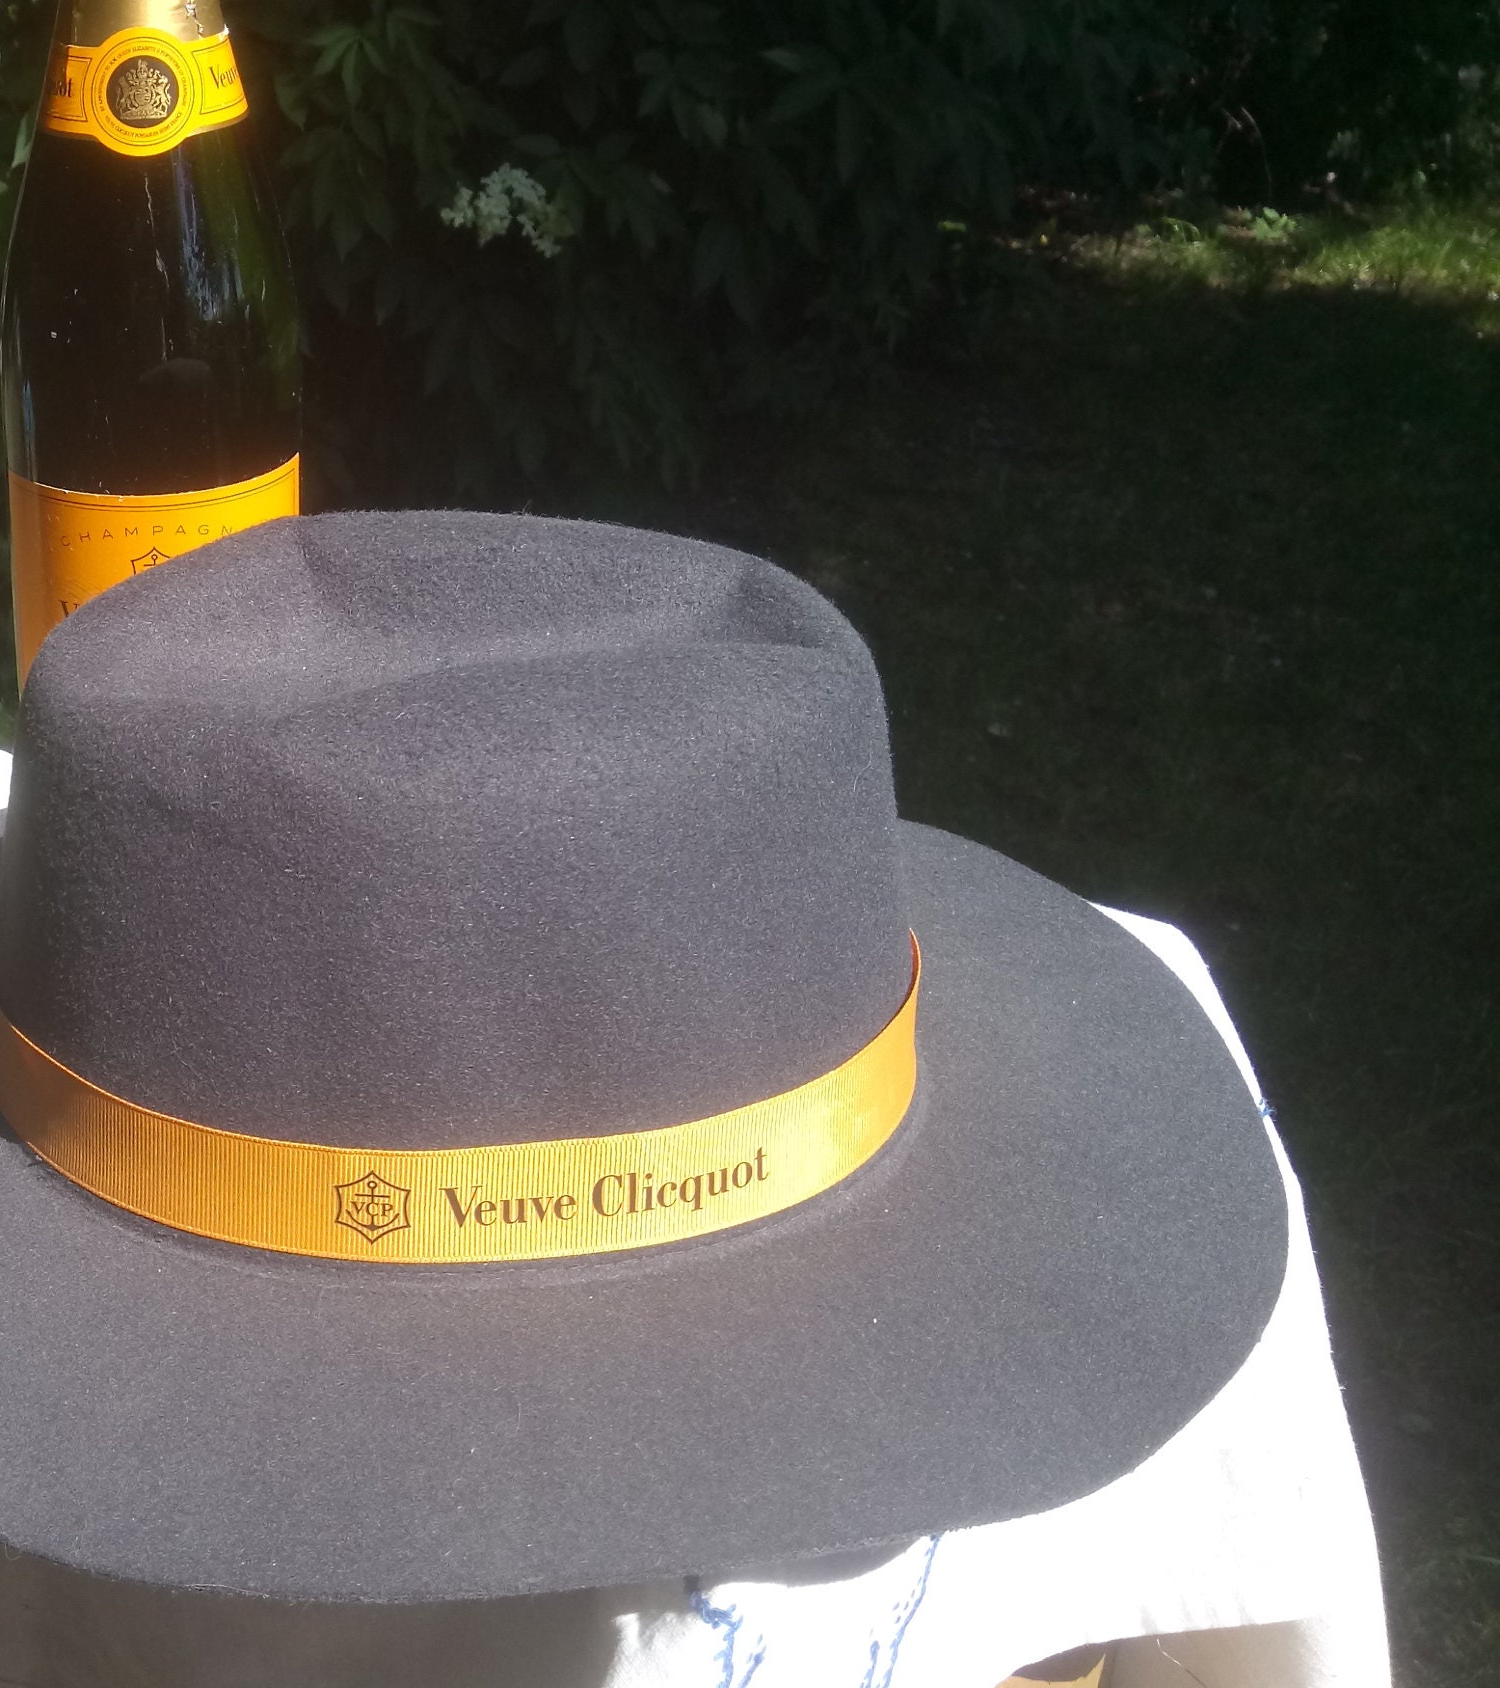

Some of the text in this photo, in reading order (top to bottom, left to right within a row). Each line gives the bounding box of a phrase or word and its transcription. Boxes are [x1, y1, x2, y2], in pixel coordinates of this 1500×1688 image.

[209, 64, 238, 89] Veu
[60, 524, 233, 547] CHAMPAGN
[439, 1146, 769, 1228] Veuve Clicquot
[350, 1200, 393, 1217] VCP
